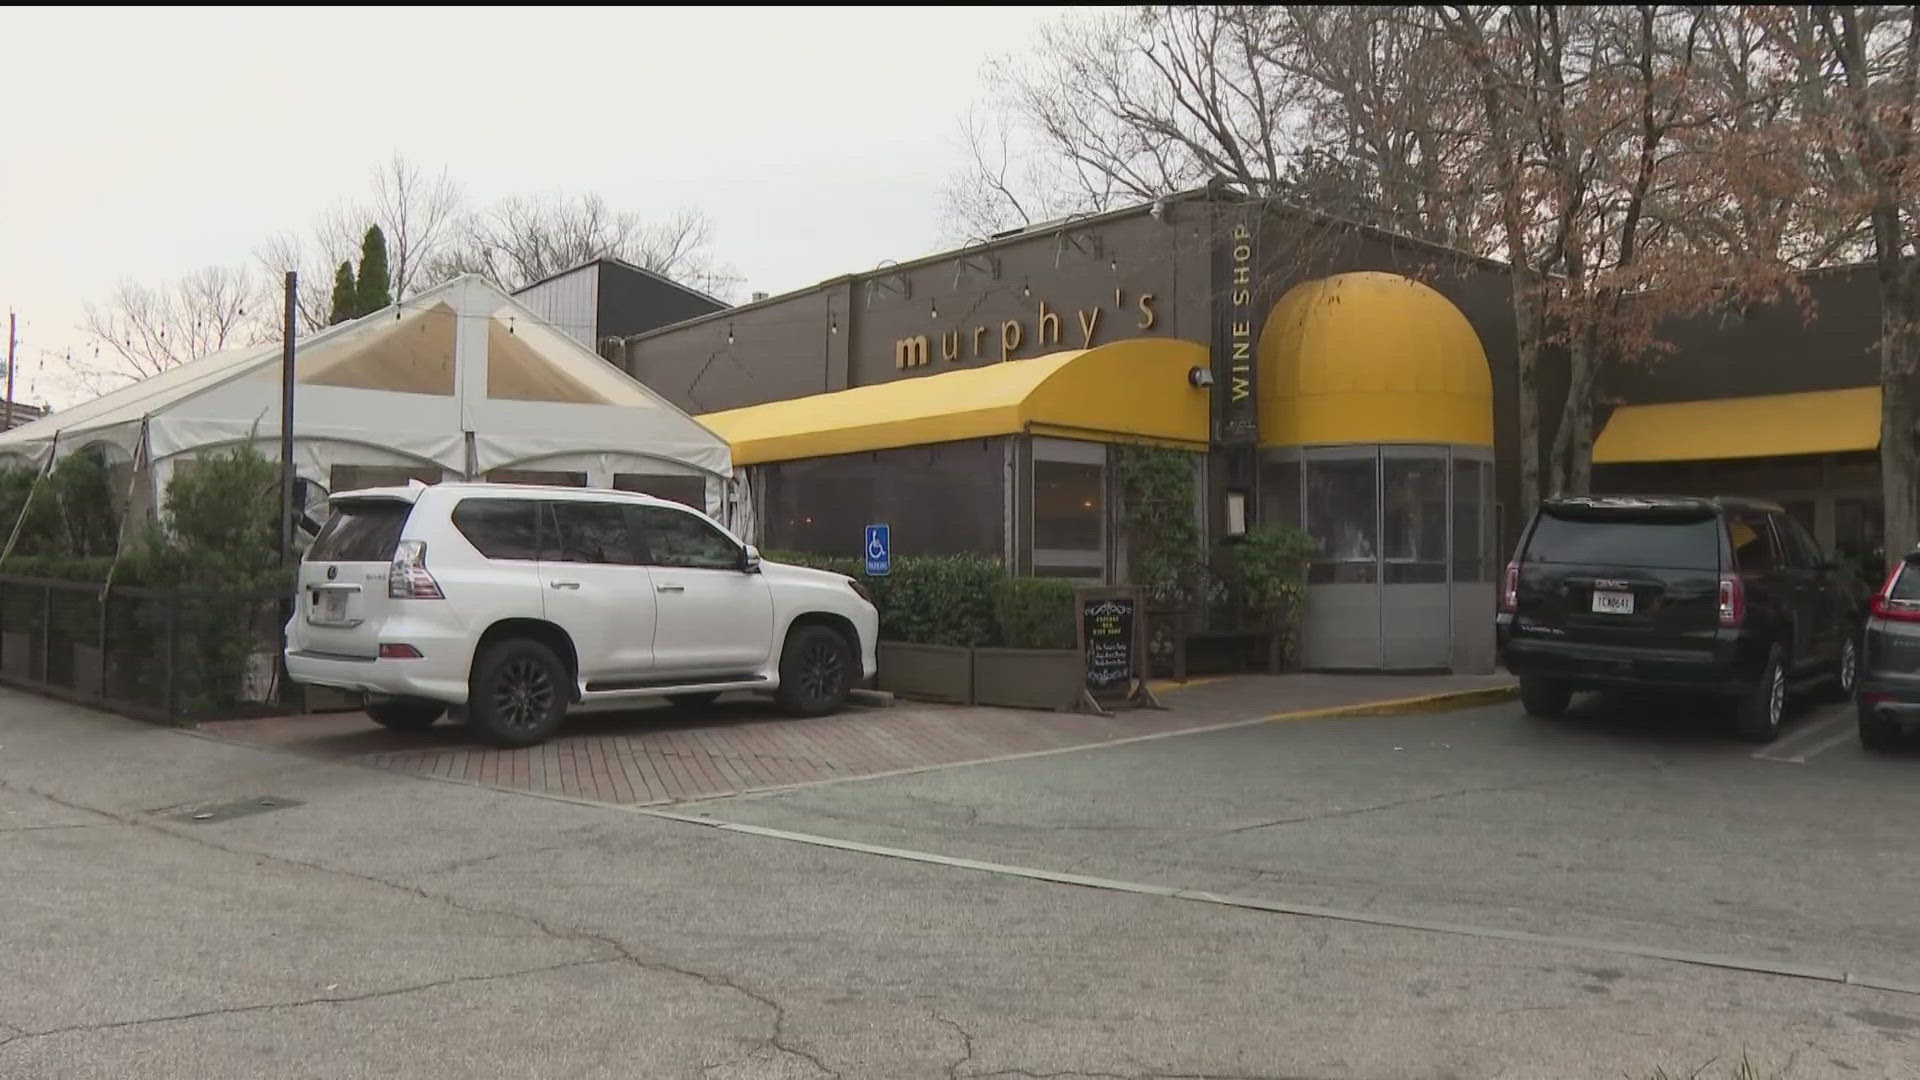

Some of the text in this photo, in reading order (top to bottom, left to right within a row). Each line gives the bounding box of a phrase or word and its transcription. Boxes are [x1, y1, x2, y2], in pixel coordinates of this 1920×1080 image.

[1232, 224, 1251, 306] SHOP
[895, 287, 1157, 369] murphy's
[1232, 320, 1250, 401] WINE
